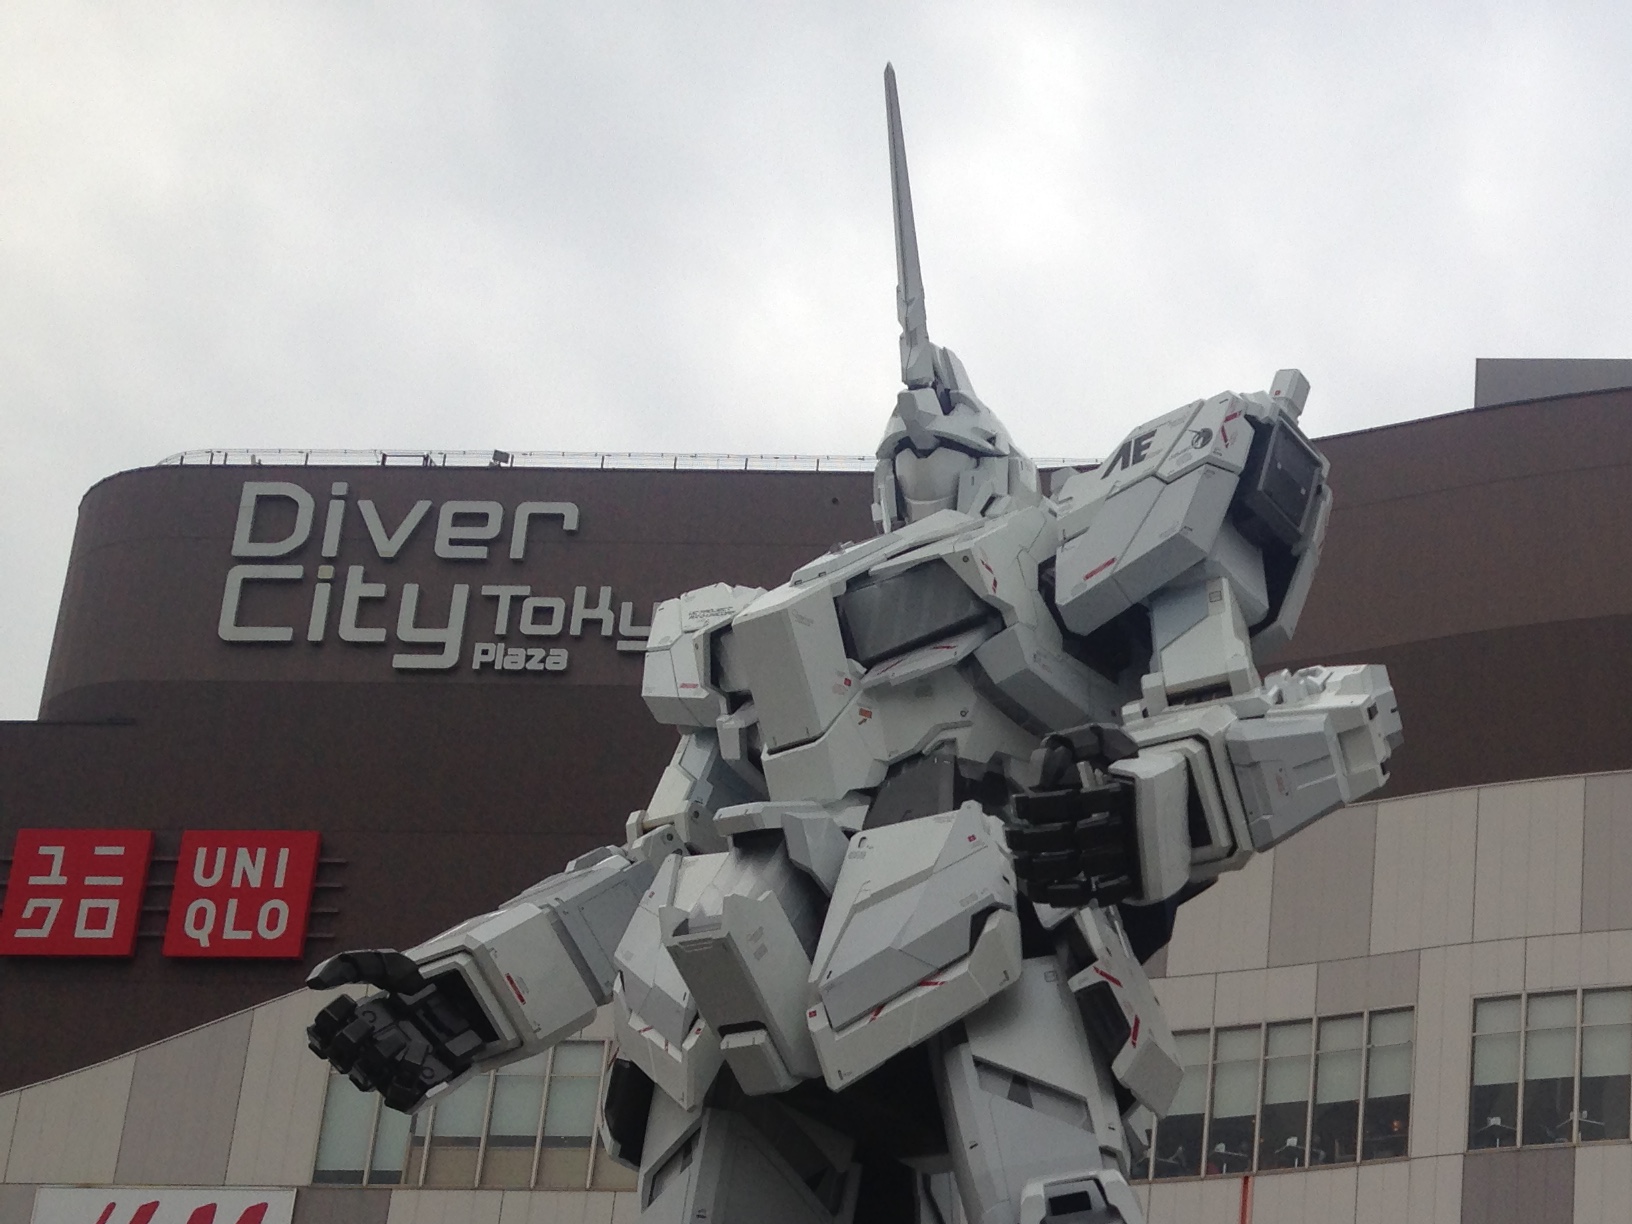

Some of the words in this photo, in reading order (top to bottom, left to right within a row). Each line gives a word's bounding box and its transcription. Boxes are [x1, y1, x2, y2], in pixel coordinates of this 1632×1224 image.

[231, 481, 580, 559] Diver
[217, 565, 470, 669] City
[481, 585, 662, 650] Toky
[472, 642, 568, 670] Plaza
[28, 846, 125, 885] ユニ
[193, 847, 289, 888] UNI
[14, 898, 120, 938] クロ
[184, 898, 290, 947] QLO
